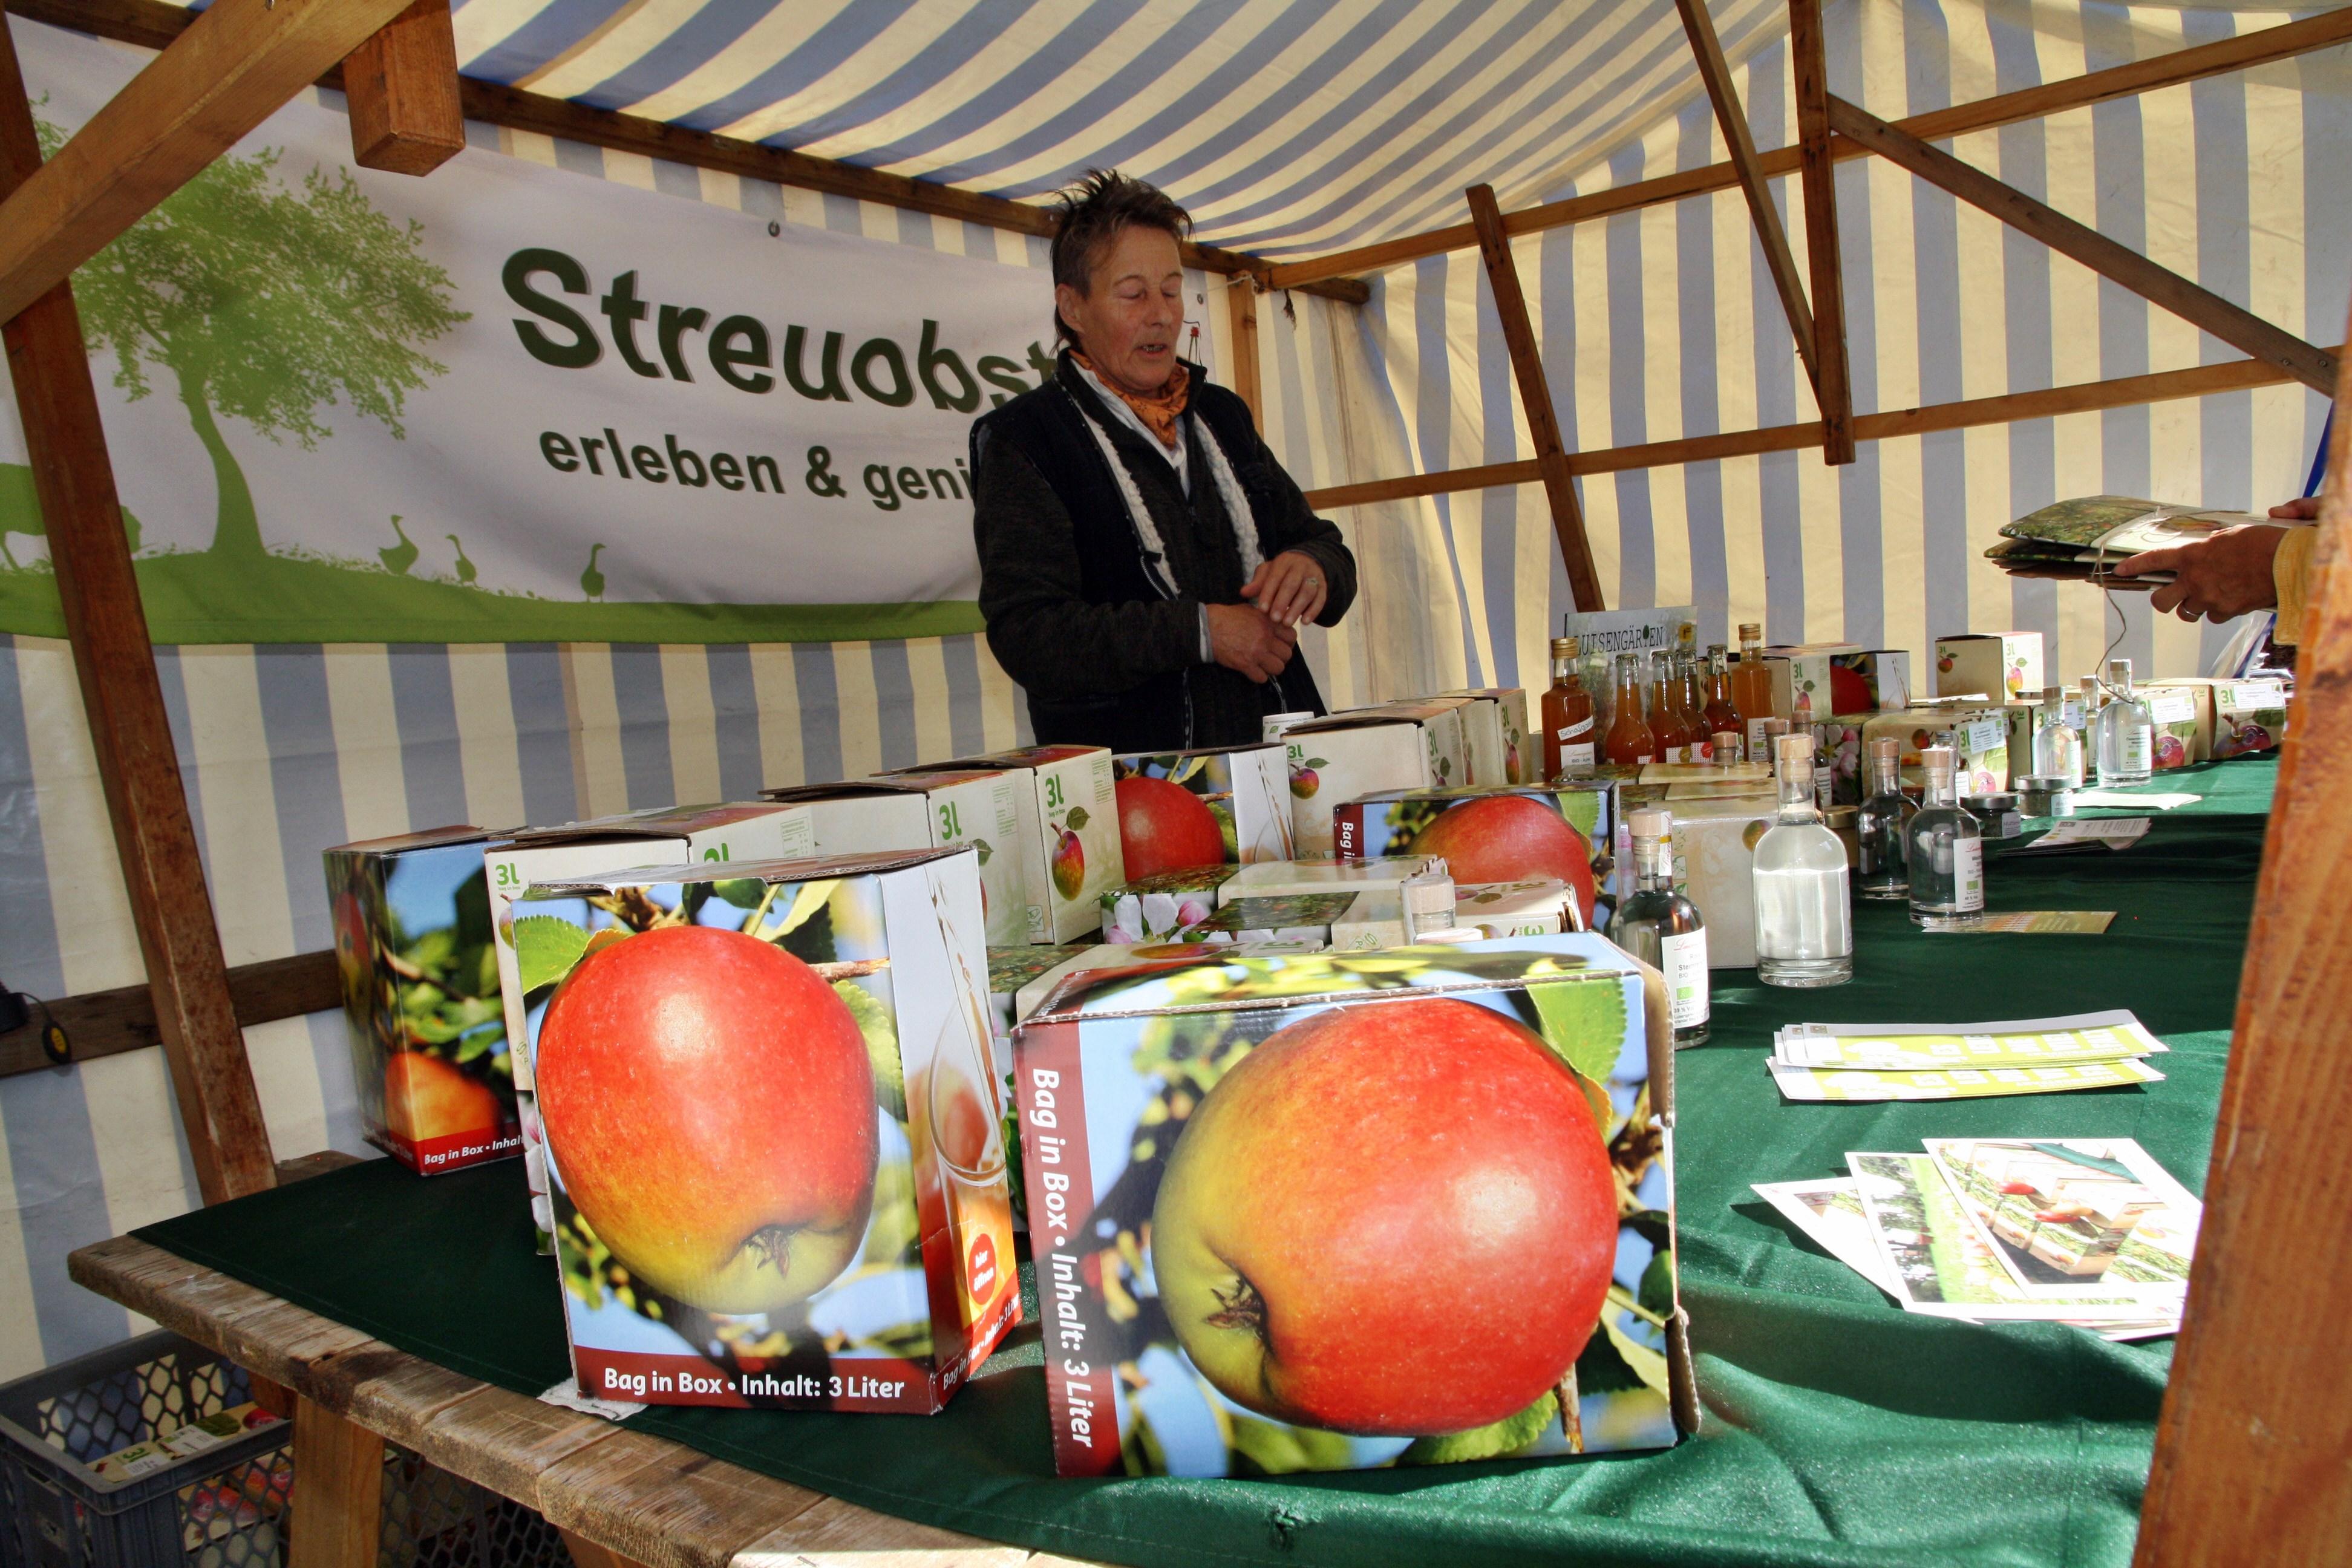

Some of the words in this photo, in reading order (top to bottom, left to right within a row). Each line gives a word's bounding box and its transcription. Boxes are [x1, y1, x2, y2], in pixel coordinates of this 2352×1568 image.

[501, 248, 1057, 414] Streuobst
[540, 428, 785, 494] erleben
[805, 446, 846, 498] &
[1287, 744, 1304, 759] 3l
[1045, 774, 1065, 808] 3l
[939, 800, 962, 840] 3l
[1339, 822, 1354, 849] Bag
[495, 862, 520, 886] 3l
[1029, 1068, 1060, 1129] Bag
[425, 1154, 445, 1165] Bag
[448, 1150, 460, 1160] in
[462, 1146, 484, 1157] Box
[1039, 1134, 1067, 1164] in
[1044, 1172, 1069, 1230] Box
[1051, 1253, 1086, 1350] Inhalt:
[604, 1368, 646, 1396] Bag
[652, 1370, 672, 1392] in
[679, 1373, 723, 1394] Box
[742, 1374, 821, 1397] Inhalt:
[829, 1376, 843, 1397] 3
[848, 1376, 904, 1398] Liter
[943, 1367, 958, 1391] Bag
[959, 1357, 967, 1374] in
[1064, 1360, 1089, 1377] 3
[1067, 1382, 1094, 1448] Liter
